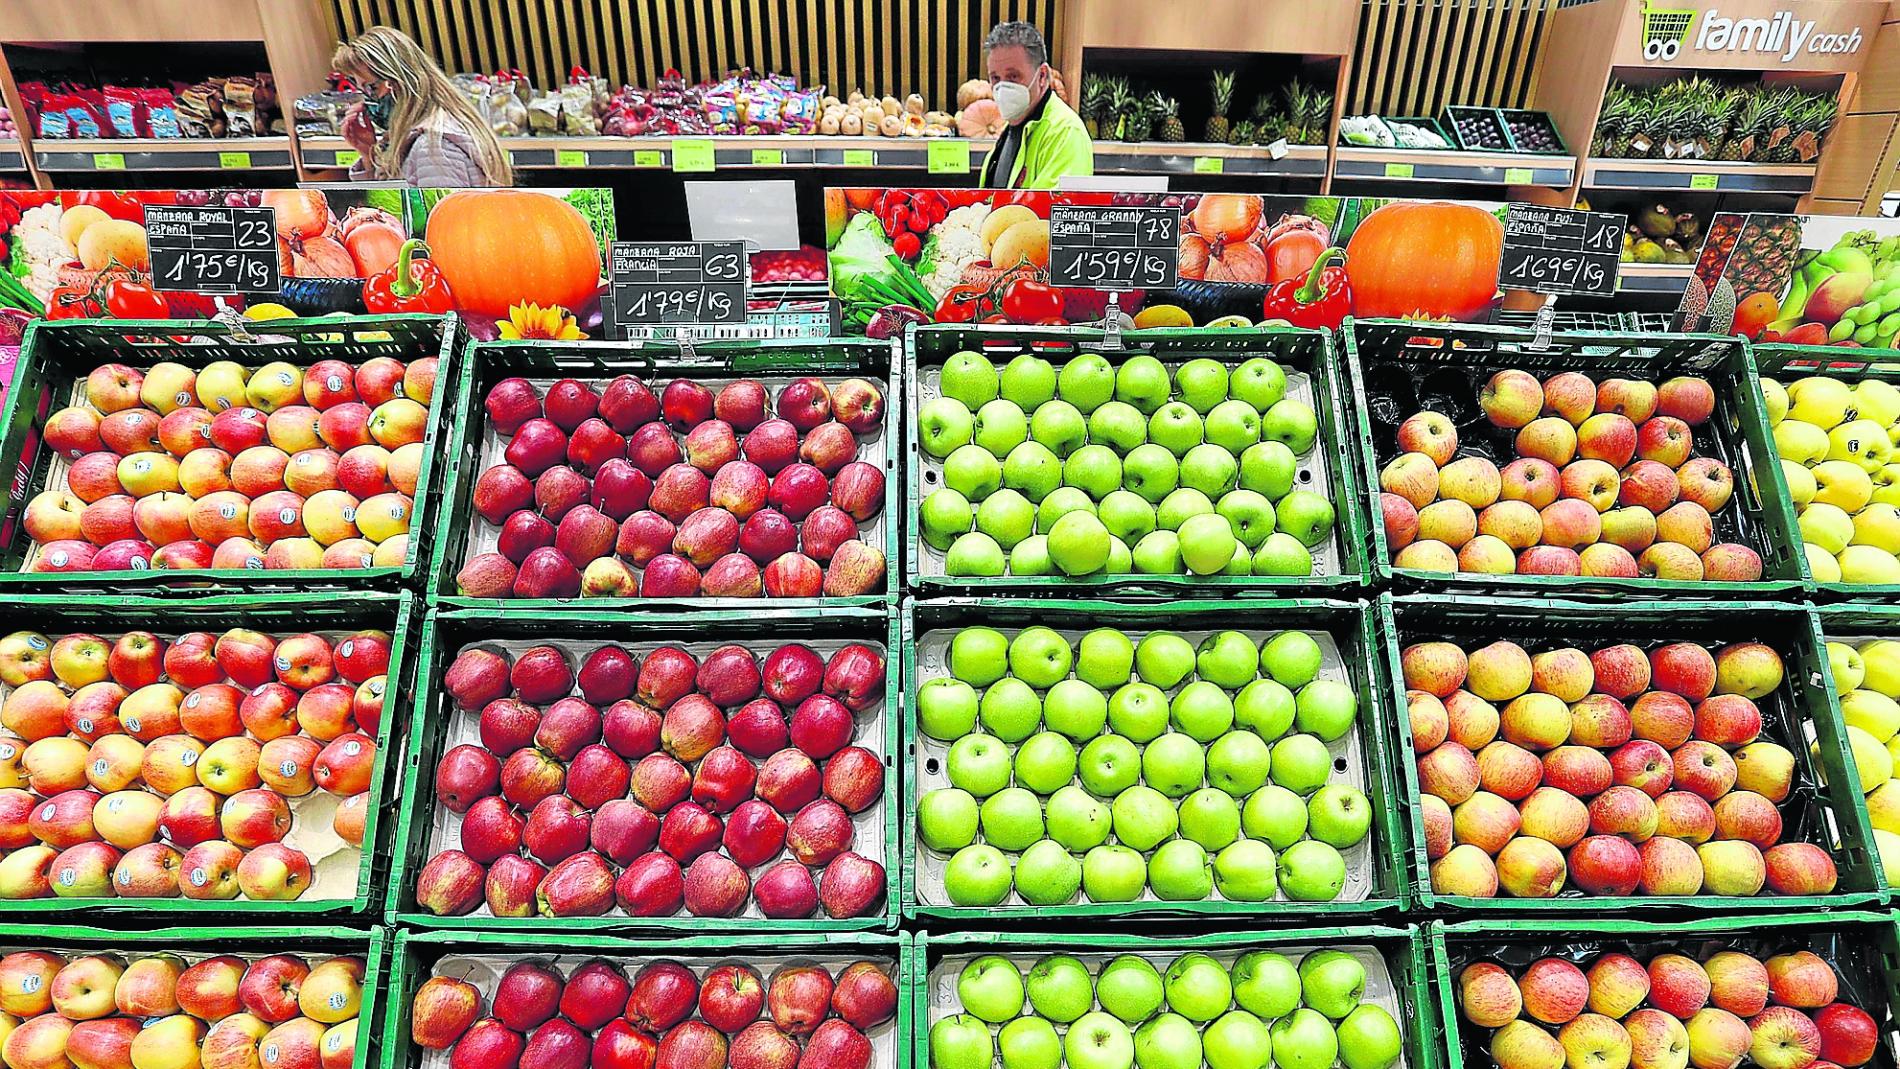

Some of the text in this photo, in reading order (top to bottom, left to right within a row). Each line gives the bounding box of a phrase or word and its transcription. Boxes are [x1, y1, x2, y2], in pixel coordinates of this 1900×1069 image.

[1695, 9, 1863, 63] family cash
[147, 211, 228, 223] MANZANA ROYAL
[1053, 211, 1144, 224] MANZANA GRANNY
[149, 223, 188, 235] ESPAÑA
[1052, 221, 1091, 233] ESPAÑA
[1143, 218, 1172, 242] 78
[1507, 220, 1545, 233] ESPAÑA
[238, 221, 272, 247] 23
[1587, 224, 1620, 249] 18
[614, 245, 696, 257] MANZANA ROJA
[705, 254, 739, 279] 63
